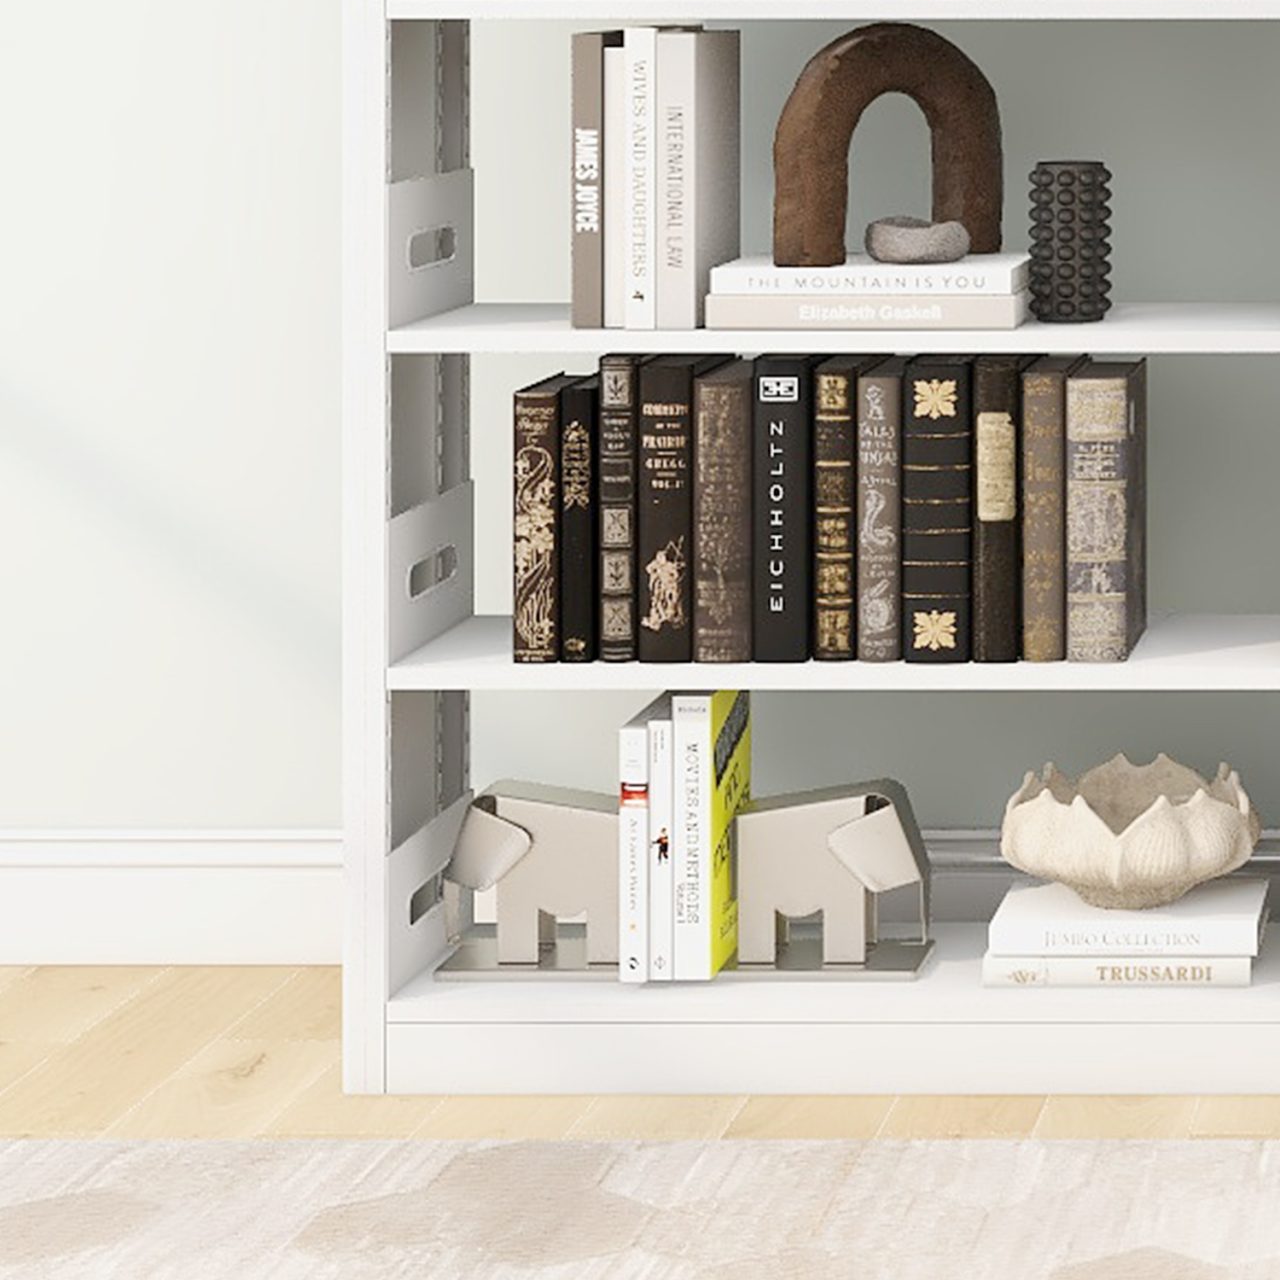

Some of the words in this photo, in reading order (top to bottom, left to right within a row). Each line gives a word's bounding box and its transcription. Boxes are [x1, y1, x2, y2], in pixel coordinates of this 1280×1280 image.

[632, 59, 647, 118] WIVES
[575, 128, 598, 181] JAMES
[632, 122, 647, 163] AND
[667, 106, 683, 230] INTERNATIONAL
[575, 183, 598, 234] JOYCE
[632, 166, 647, 278] DAUGHTERS
[667, 235, 683, 269] LAW
[747, 277, 781, 289] THE
[795, 277, 907, 289] MOUNTAIN
[915, 277, 933, 289] IS
[942, 277, 987, 289] YOU
[799, 305, 876, 320] Elizabeth
[880, 305, 942, 320] Gaskell
[770, 421, 785, 612] EICHHOLTZ
[685, 742, 700, 806] MOVIES
[685, 809, 700, 845] AND
[685, 846, 700, 925] METHODS
[1096, 965, 1212, 982] TRUSSARDI
